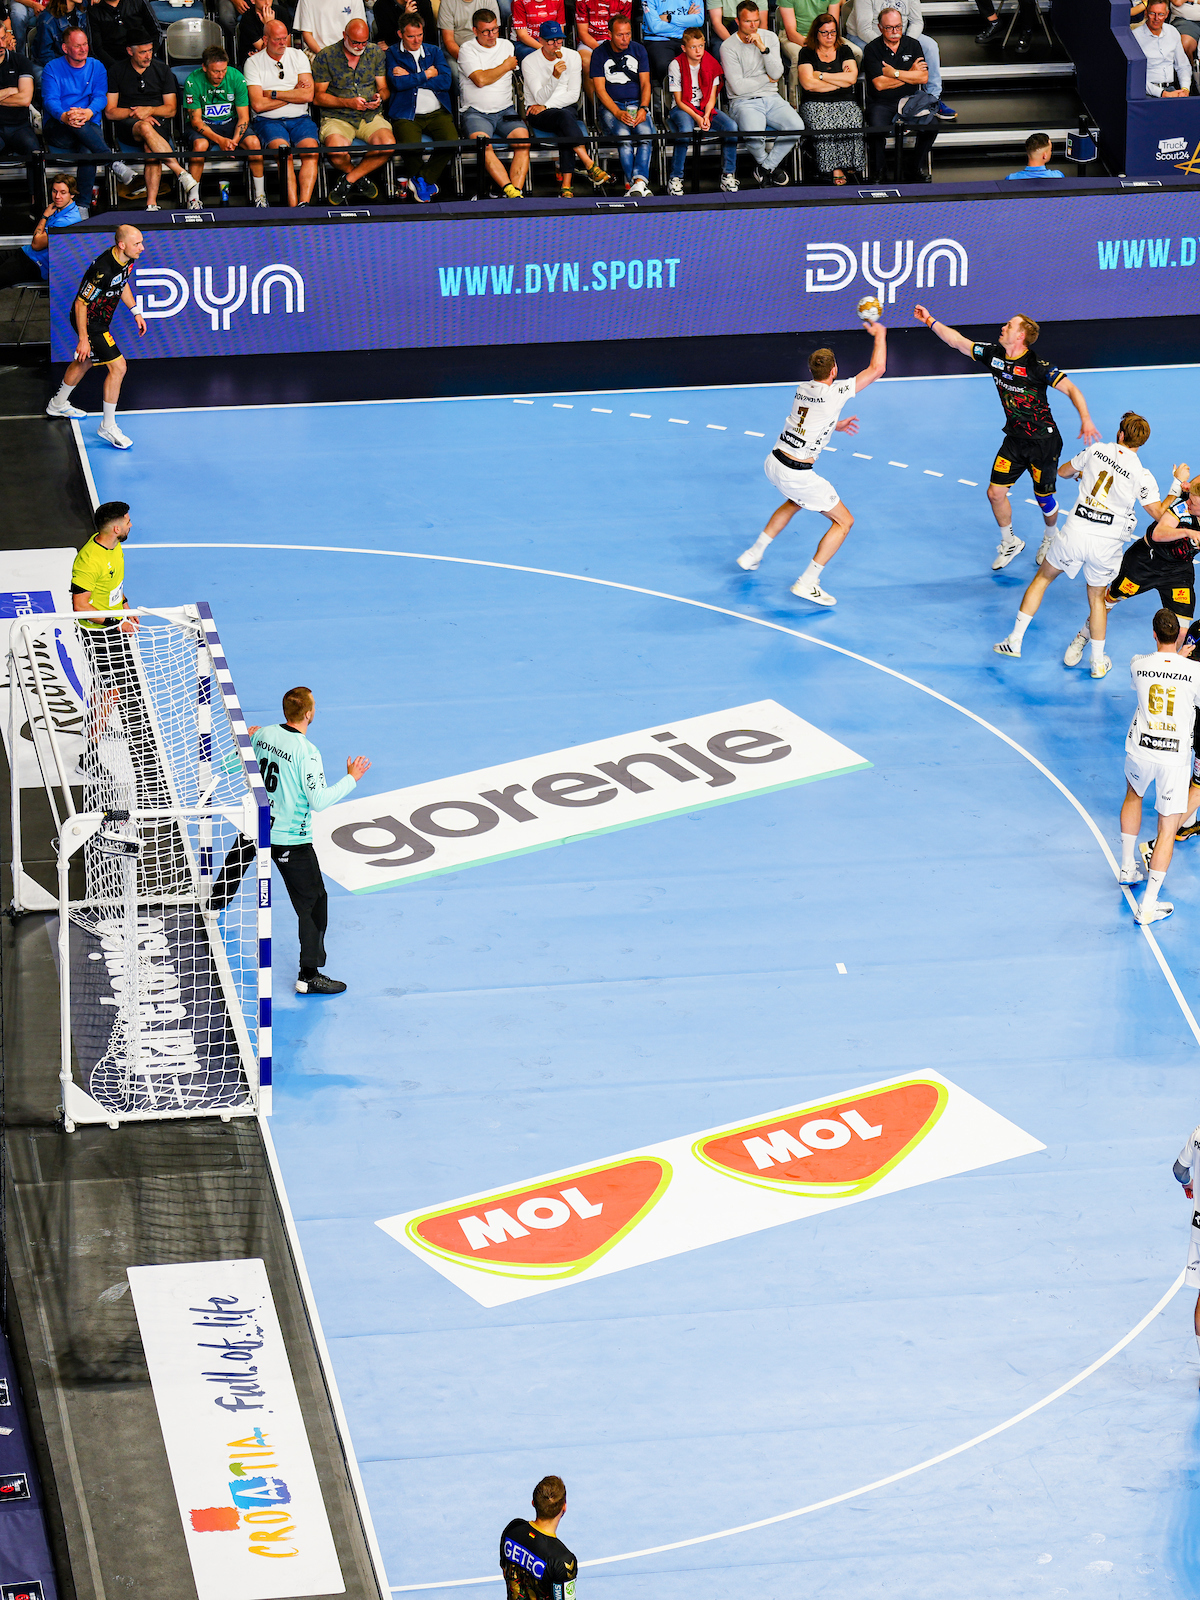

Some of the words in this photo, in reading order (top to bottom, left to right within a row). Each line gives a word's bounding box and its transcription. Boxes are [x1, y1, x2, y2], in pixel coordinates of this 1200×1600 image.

[206, 104, 231, 116] AVK
[1155, 151, 1190, 161] Scout24
[1162, 141, 1185, 150] Truck
[438, 258, 681, 298] WWW.DYN.SPORT
[806, 237, 968, 304] DYN
[135, 263, 304, 331] DYN
[1087, 511, 1112, 523] ORLEN
[12, 592, 33, 617] BLU
[1136, 669, 1193, 683] PROVINZIAL
[1148, 683, 1177, 717] 61
[1151, 738, 1178, 749] ORLEN
[259, 757, 280, 793] 16
[331, 728, 792, 868] gorenje
[741, 1108, 883, 1170] MOL
[457, 1187, 604, 1251] MOL
[201, 1366, 265, 1413] Full
[226, 1427, 299, 1559] CROATIA
[503, 1540, 545, 1578] GETEC
